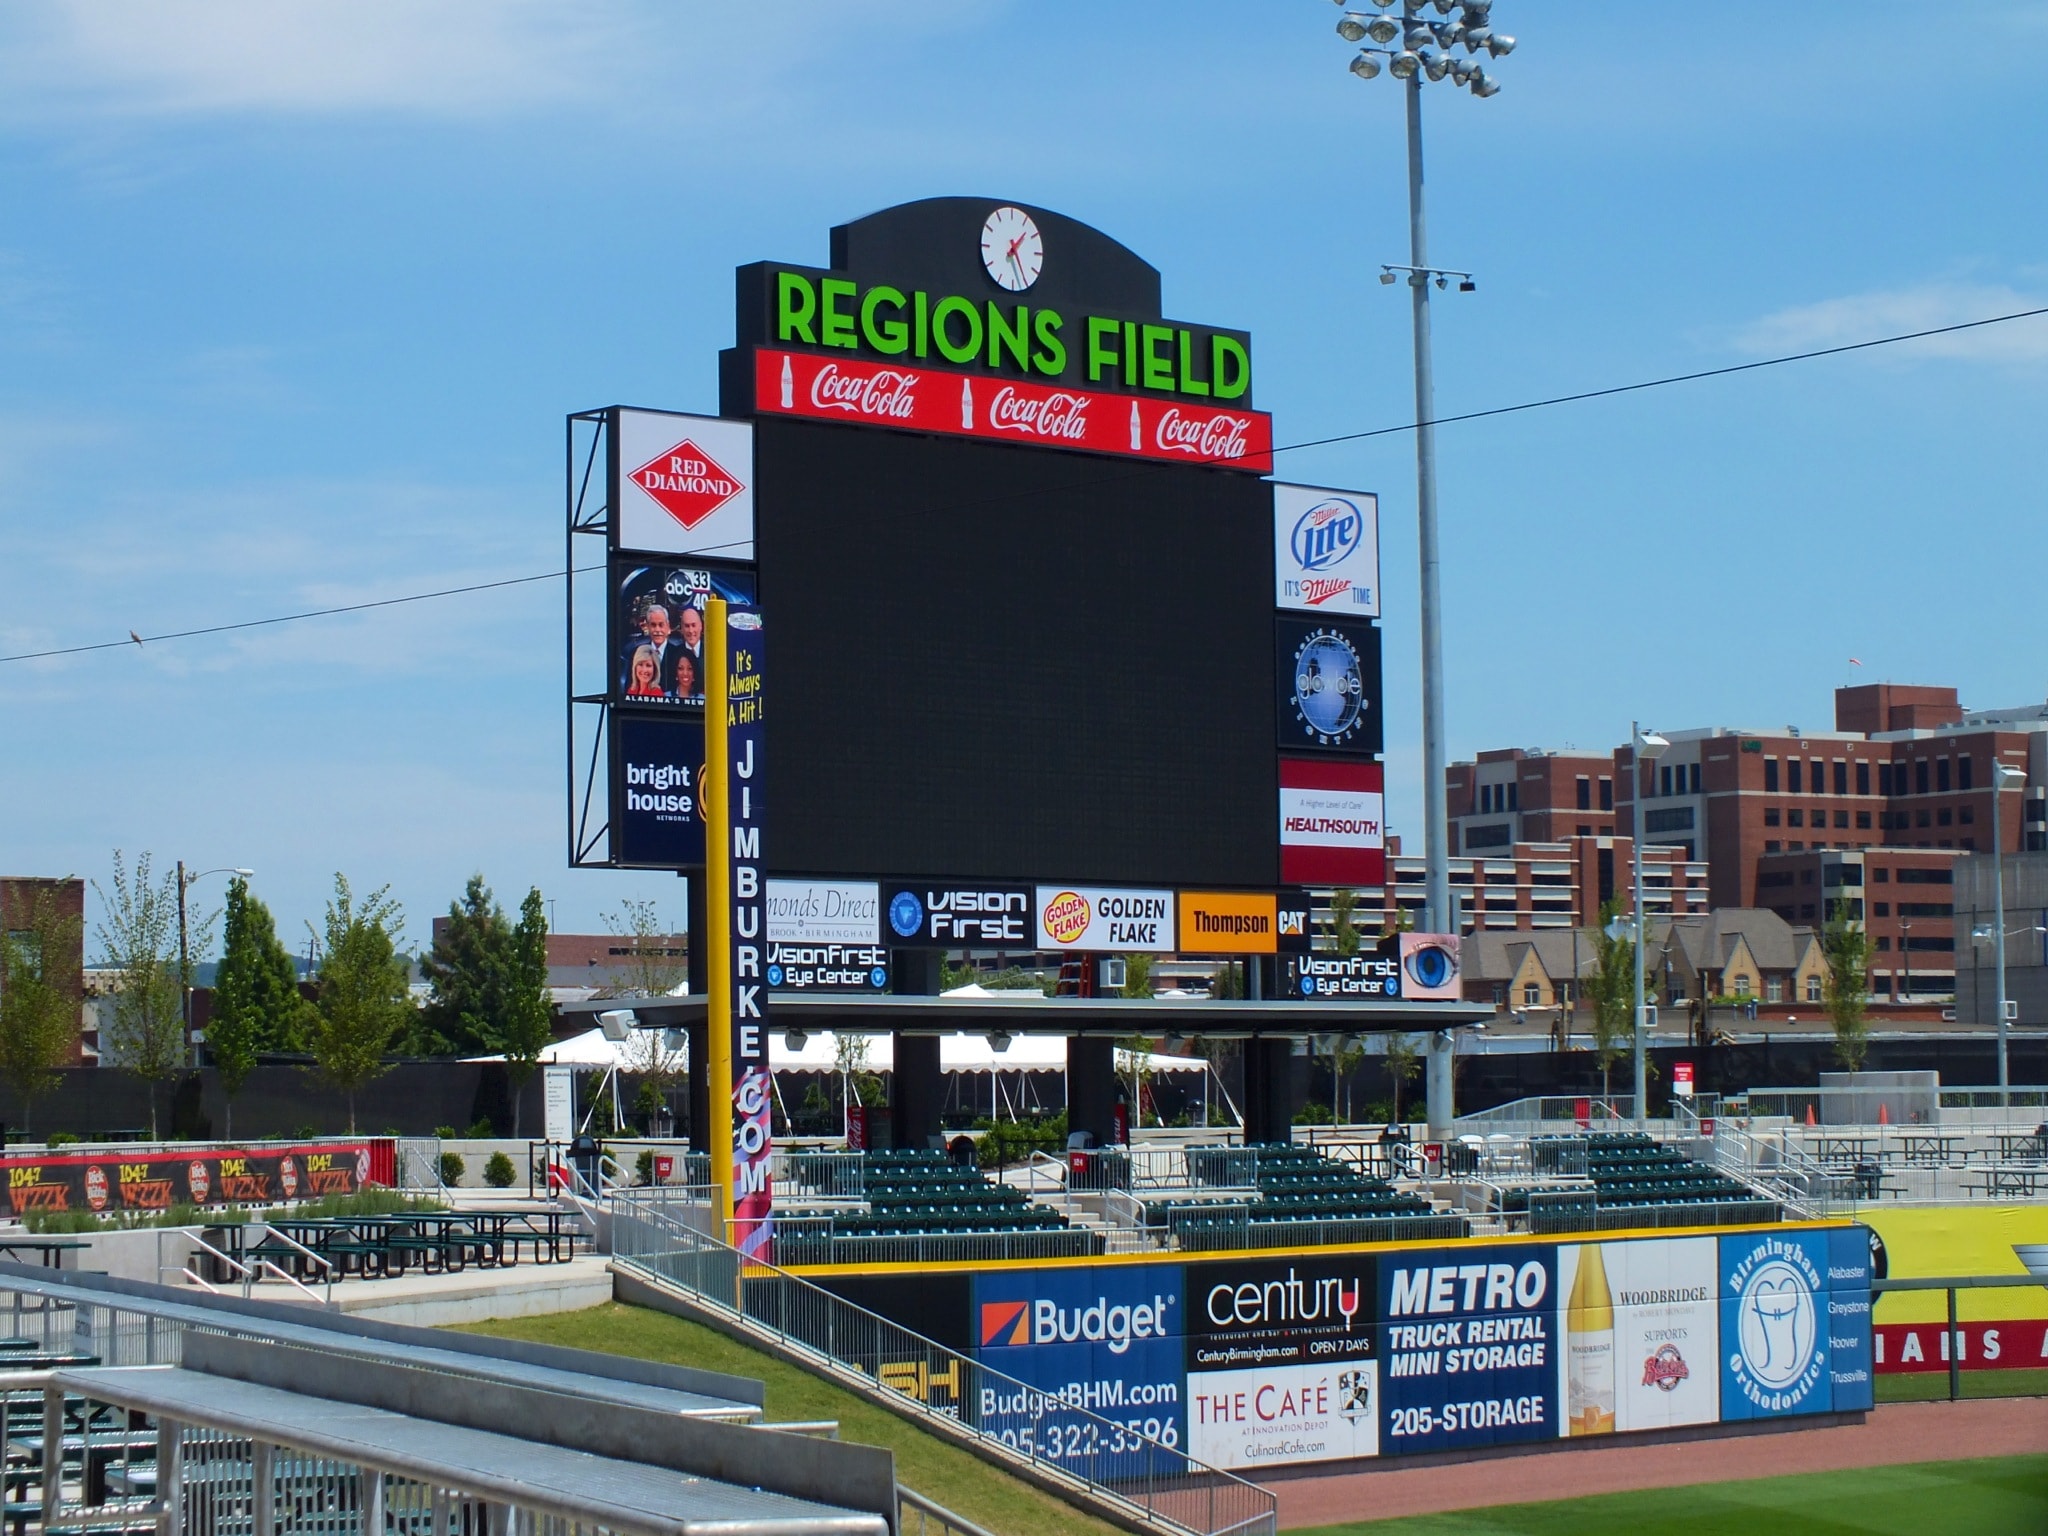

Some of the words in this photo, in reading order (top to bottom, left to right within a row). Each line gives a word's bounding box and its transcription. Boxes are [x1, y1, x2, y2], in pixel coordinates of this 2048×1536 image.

[777, 271, 1067, 376] REGIONS
[1087, 316, 1250, 399] FIELD
[811, 363, 919, 418] Coca-Cola
[989, 386, 1091, 439] Coca-Cola
[1156, 408, 1252, 459] Coca-Cola
[670, 456, 707, 476] RED
[644, 470, 733, 496] DIAMOND
[1301, 515, 1354, 571] Lite
[665, 577, 693, 596] abc
[692, 571, 709, 588] 33
[1284, 580, 1300, 597] IT'S
[1300, 578, 1352, 604] Miller
[1352, 587, 1372, 605] TIME
[736, 649, 752, 673] It's
[729, 673, 761, 697] Always
[625, 694, 680, 705] ALABAMA'S
[728, 707, 736, 727] A
[627, 763, 690, 790] bright
[627, 789, 692, 813] house
[1306, 799, 1325, 809] Higher
[1326, 801, 1339, 809] Level
[1341, 801, 1348, 809] of
[656, 814, 690, 822] NETWORKS
[1285, 817, 1378, 835] HEALTHSOUTH
[824, 890, 876, 919] Direct
[1047, 898, 1085, 921] GOLDEN
[1098, 897, 1165, 919] GOLDEN
[770, 928, 798, 937] BROOK
[805, 928, 872, 938] BIRMINGHAM
[1053, 912, 1086, 940] FLAKE
[1109, 923, 1157, 943] FLAKE
[1193, 910, 1268, 935] Thompson
[1278, 911, 1307, 935] CAT
[786, 967, 813, 986] Eye
[817, 967, 867, 984] Center
[1316, 977, 1340, 995] Eye
[1341, 977, 1383, 993] Center
[119, 1180, 174, 1207] WZZK
[220, 1174, 270, 1199] WZZK
[307, 1170, 353, 1193] WZZK
[9, 1184, 70, 1214] WZZK
[1729, 1237, 1822, 1293] Birmingham
[1827, 1266, 1865, 1280] Alabaster
[1207, 1267, 1359, 1332] century
[1389, 1260, 1547, 1316] METRO
[1619, 1286, 1707, 1306] WOODBRIDGE
[1827, 1301, 1870, 1316] Greystone
[1034, 1295, 1166, 1353] Budget
[1210, 1332, 1249, 1341] restaurant
[1252, 1330, 1266, 1339] and
[1268, 1329, 1280, 1338] bar
[1300, 1327, 1312, 1335] the
[1389, 1322, 1462, 1349] TRUCK
[1467, 1316, 1546, 1344] RENTAL
[1644, 1327, 1688, 1342] SUPPORTS
[1197, 1344, 1298, 1364] CenturyBirmingham.com
[1310, 1340, 1336, 1355] OPEN
[1337, 1340, 1345, 1352] 7
[1346, 1338, 1369, 1351] DAYS
[1828, 1336, 1858, 1349] Hoover
[1390, 1350, 1440, 1378] MINI
[1445, 1343, 1545, 1373] STORAGE
[1730, 1350, 1825, 1411] Orthodontics
[1829, 1370, 1868, 1383] Trussville
[981, 1379, 1177, 1419] BudgetBHM.com
[1196, 1393, 1246, 1424] THE
[1255, 1377, 1328, 1421] CAFÉ
[1390, 1396, 1544, 1436] 205-STORAGE
[1241, 1427, 1250, 1436] AT
[1252, 1423, 1302, 1436] INNOVATION
[1304, 1421, 1328, 1432] DEPOT
[1244, 1439, 1325, 1458] CulinardCafe.com
